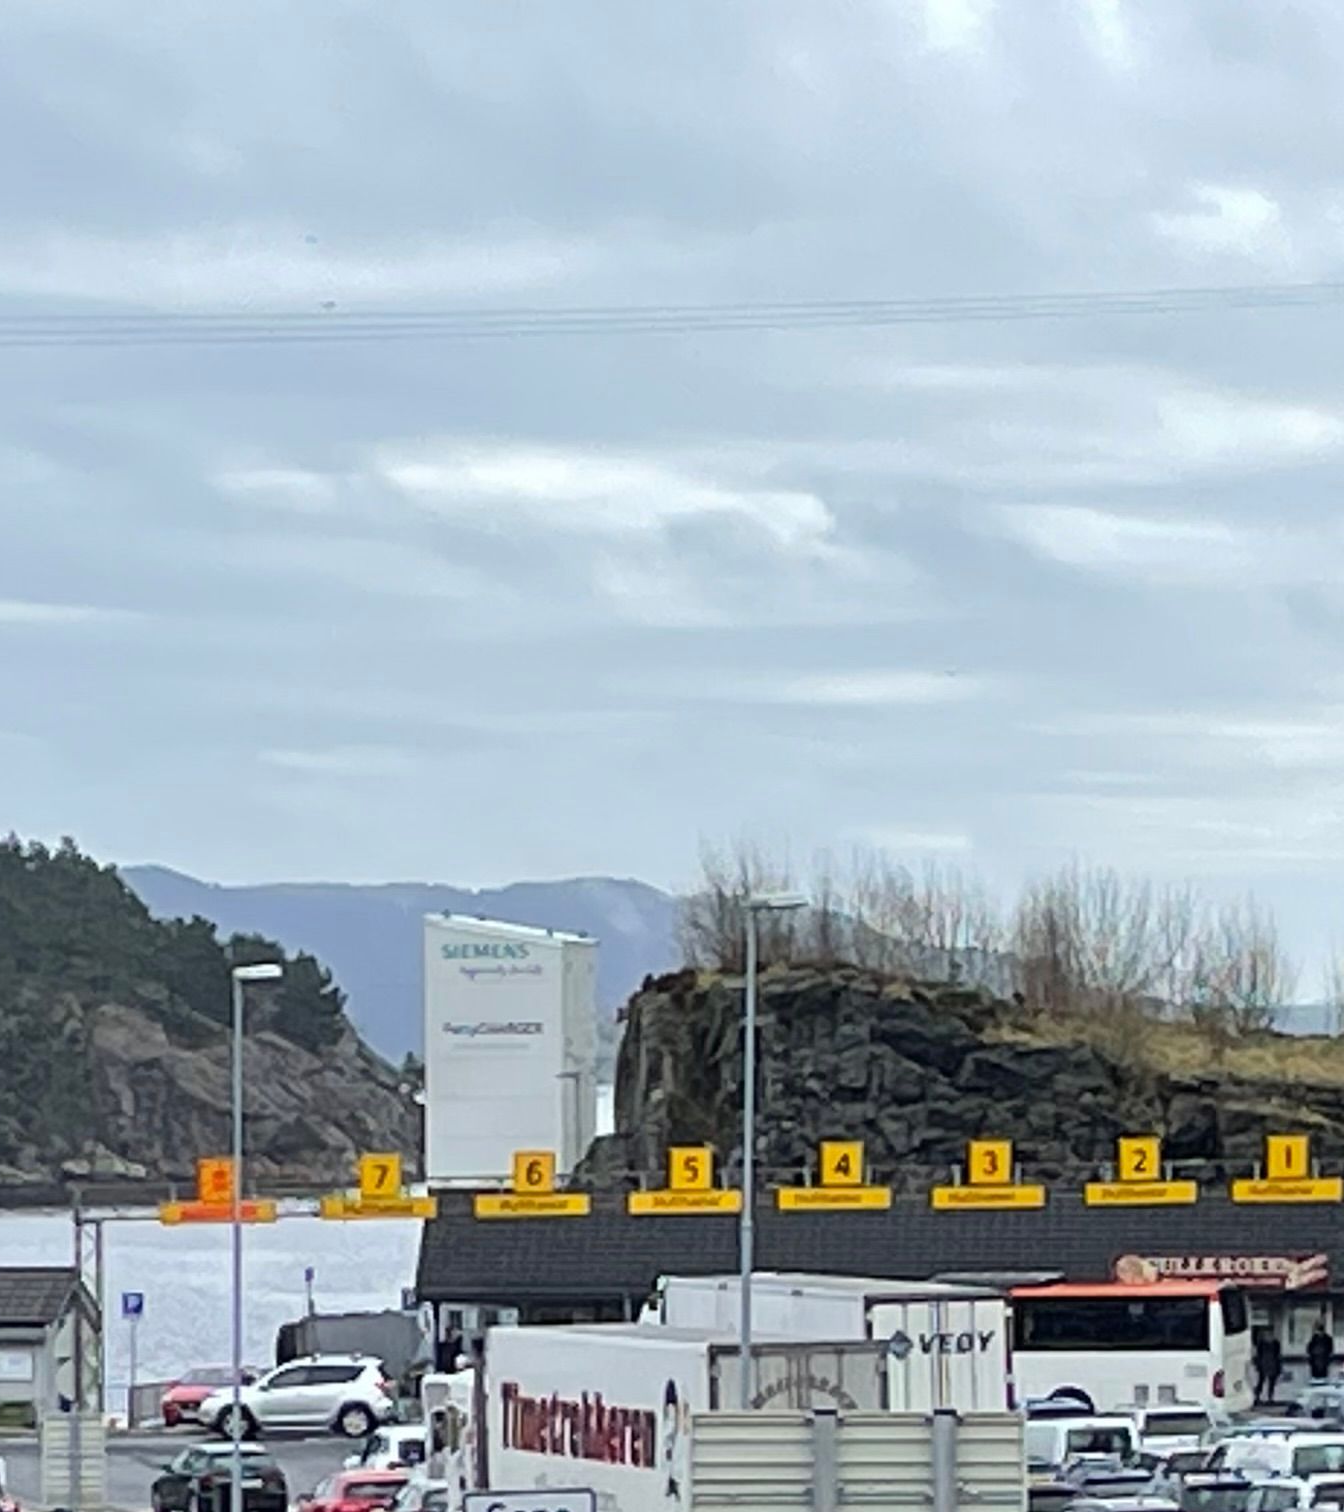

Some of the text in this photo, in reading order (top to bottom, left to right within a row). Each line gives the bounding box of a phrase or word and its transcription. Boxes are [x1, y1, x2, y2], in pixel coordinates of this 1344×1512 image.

[441, 943, 530, 959] SIEMENS
[682, 1155, 699, 1182] 5
[834, 1152, 851, 1177] 4
[981, 1150, 999, 1176] 3
[1132, 1149, 1148, 1173] 2
[1284, 1144, 1293, 1169] 1
[373, 1164, 389, 1189] 7
[525, 1159, 542, 1185] 6
